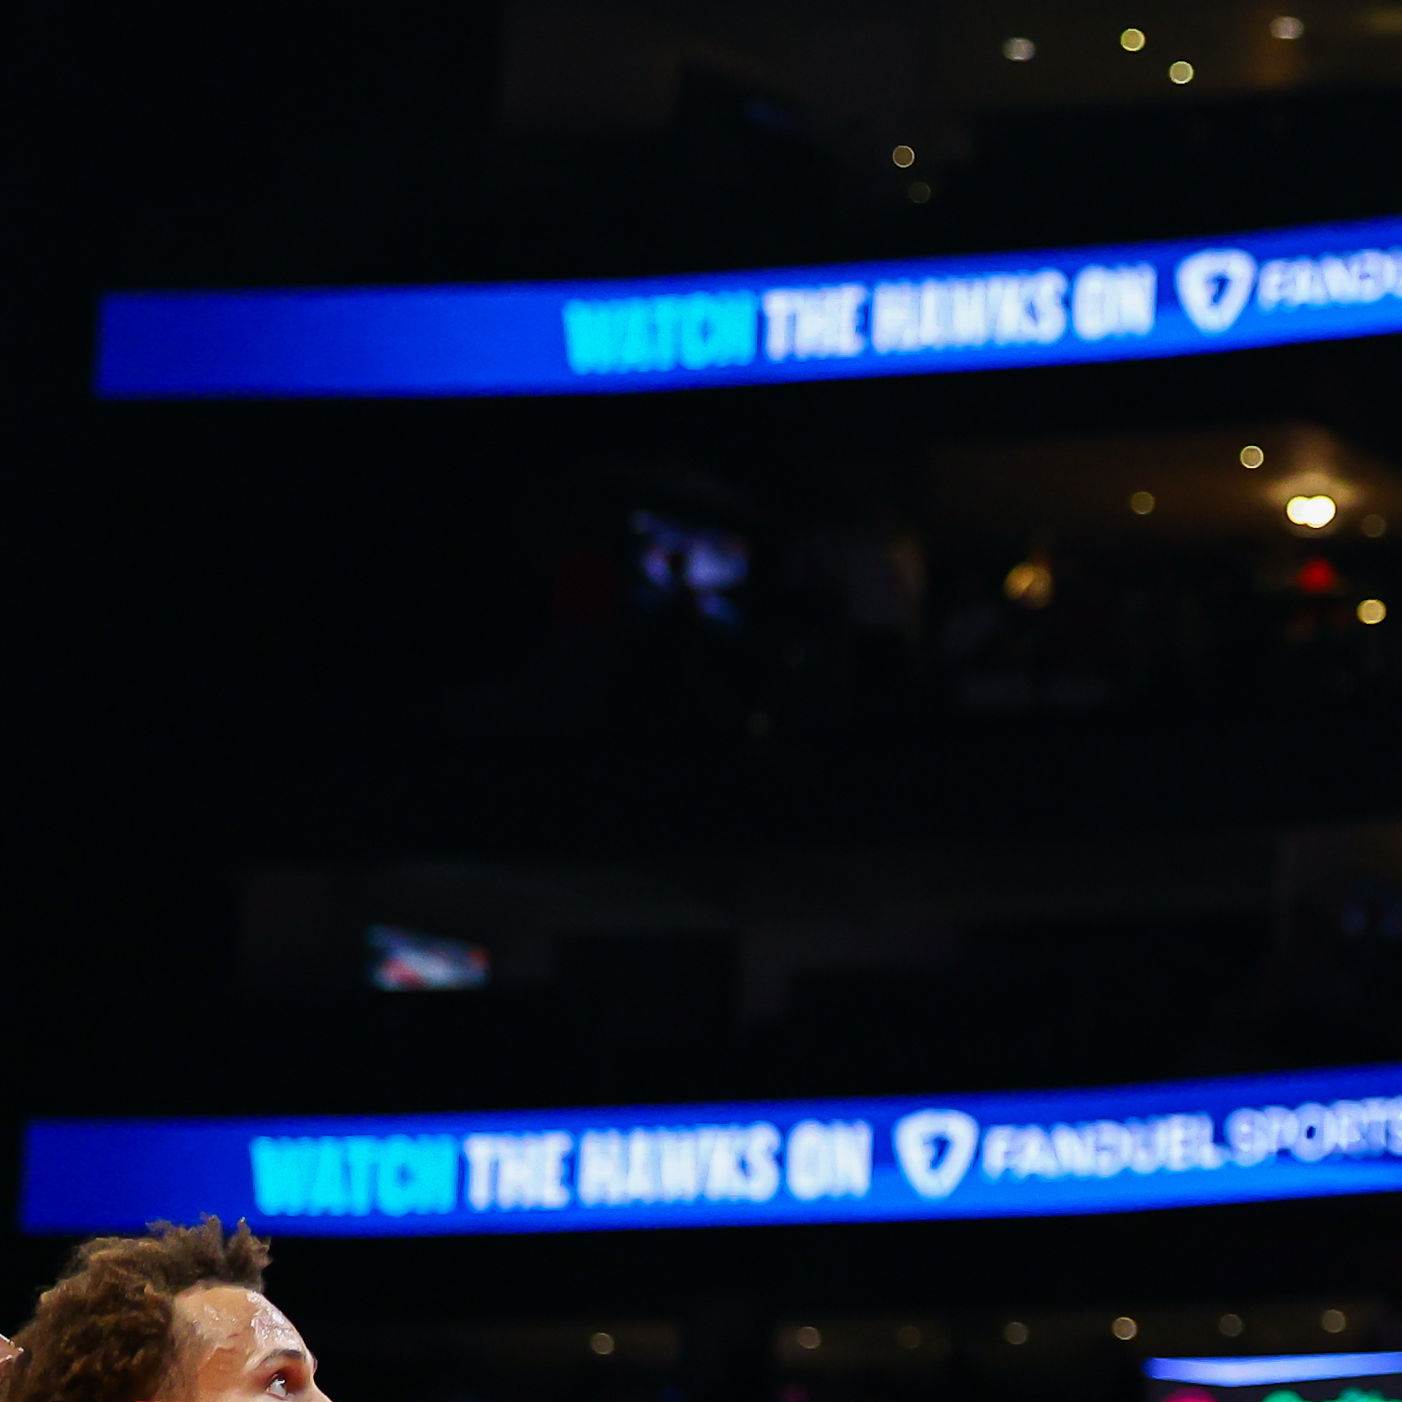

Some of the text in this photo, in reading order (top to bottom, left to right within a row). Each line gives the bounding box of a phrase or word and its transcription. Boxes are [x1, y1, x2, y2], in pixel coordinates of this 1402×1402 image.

[565, 290, 757, 373] WATCH
[762, 282, 868, 362] THE
[872, 267, 1067, 353] HAWKS
[1073, 263, 1157, 341] ON
[250, 1135, 458, 1217] WATCH
[463, 1130, 573, 1210] THE
[577, 1121, 783, 1207] HAWKS
[786, 1118, 874, 1200] ON
[982, 1114, 1228, 1182] FANDUEL
